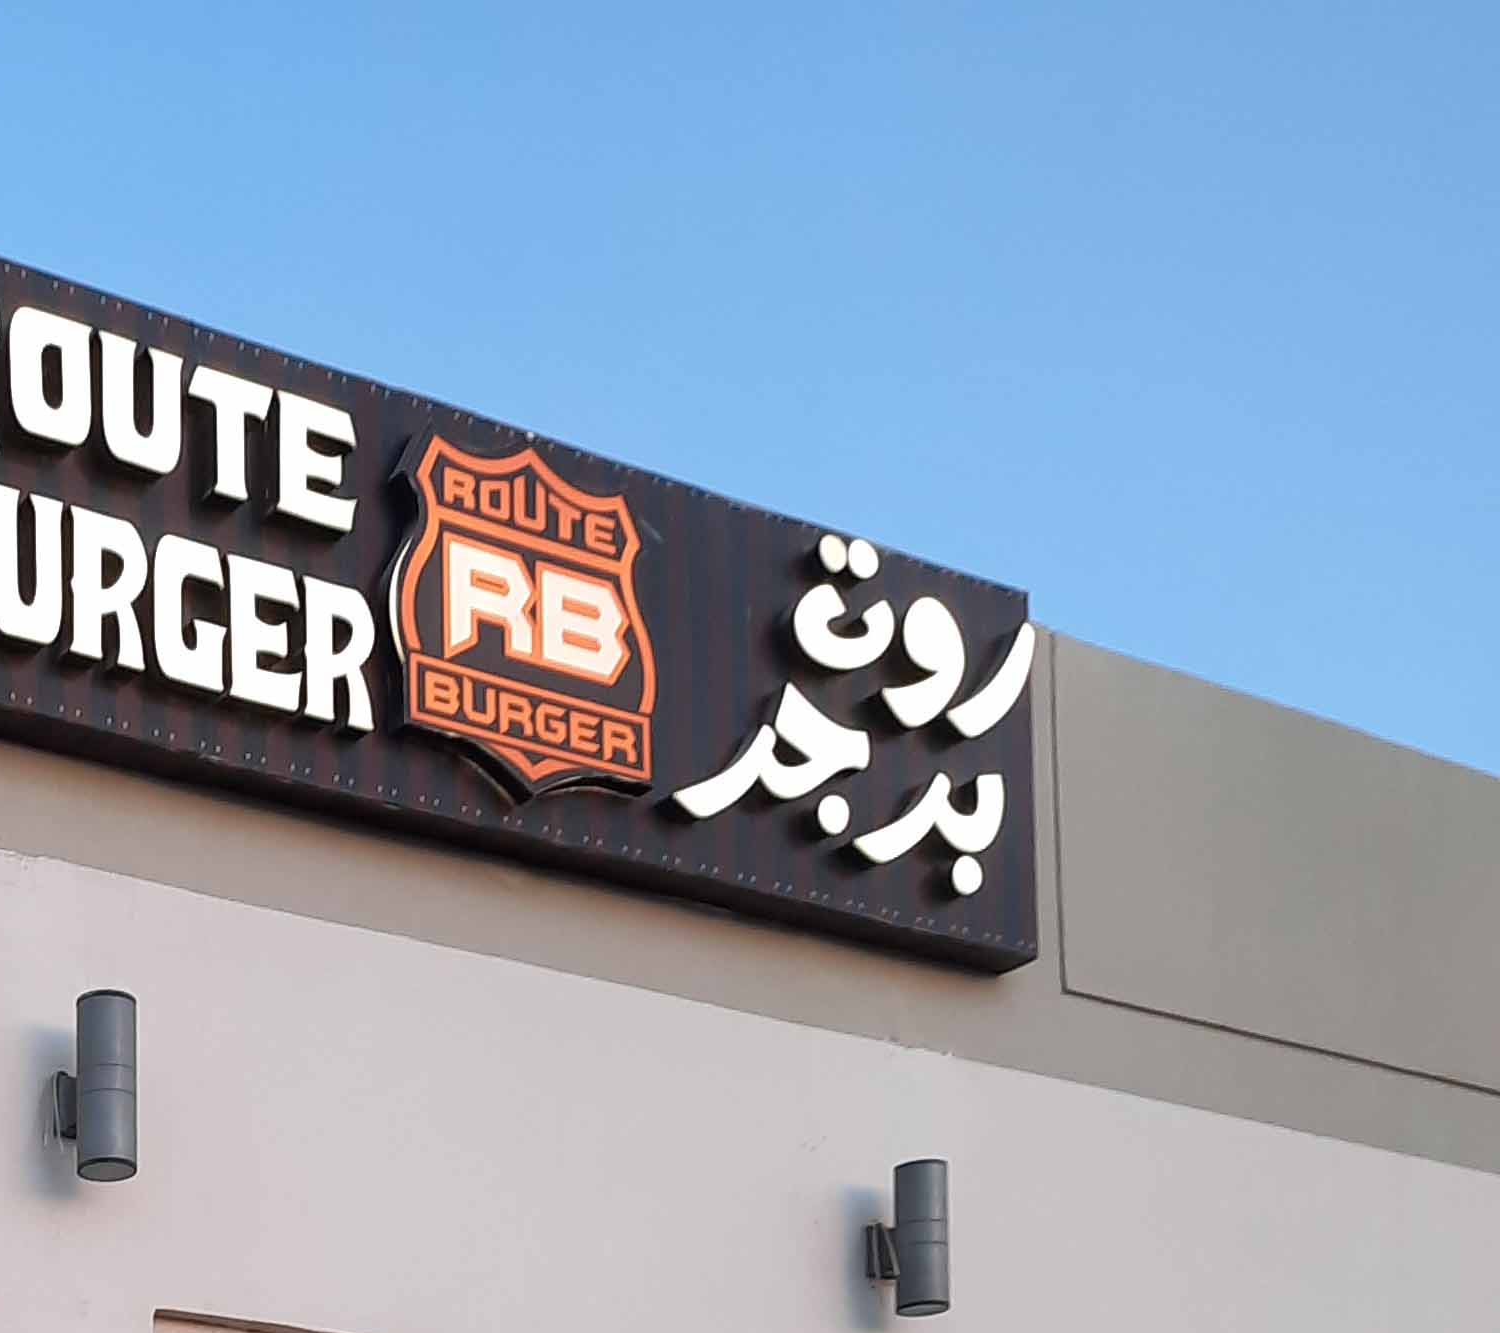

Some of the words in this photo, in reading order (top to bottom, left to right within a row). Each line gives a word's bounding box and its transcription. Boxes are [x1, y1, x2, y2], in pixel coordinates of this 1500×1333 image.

[443, 466, 618, 556] ROUTE
[443, 531, 633, 688] RB
[794, 534, 1036, 739] روت
[423, 670, 638, 764] BURGER
[673, 681, 1006, 896] برجر
